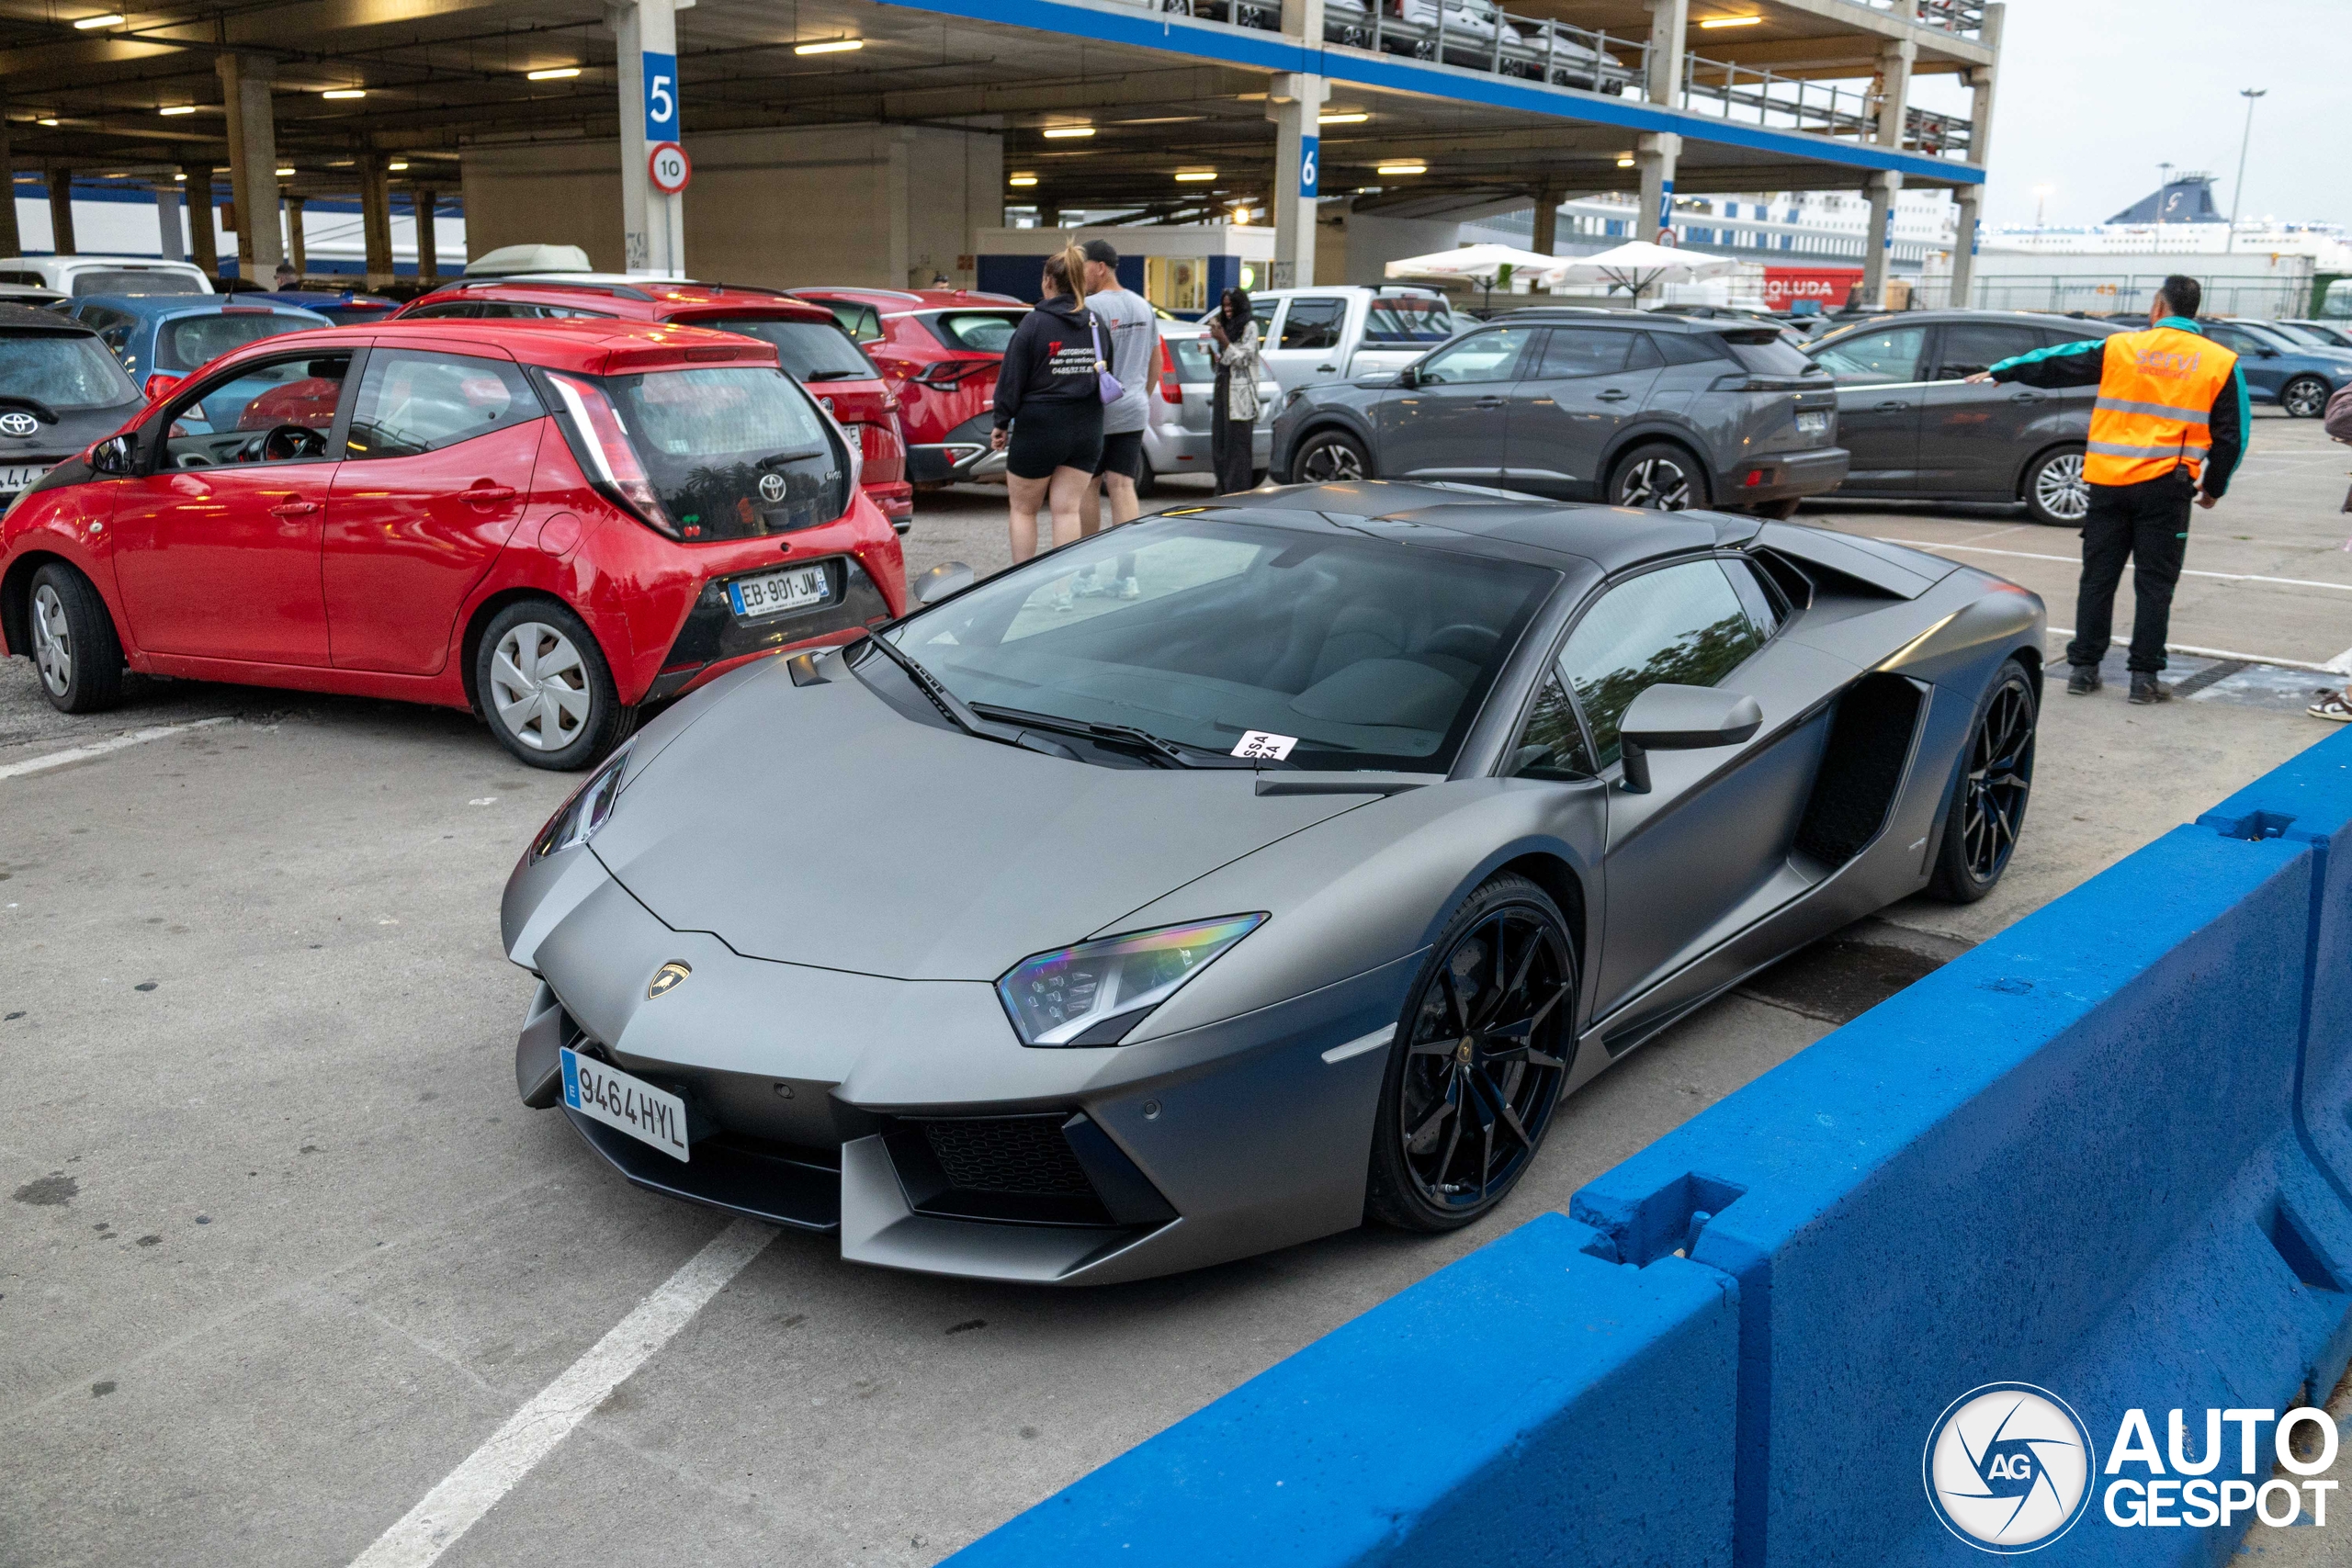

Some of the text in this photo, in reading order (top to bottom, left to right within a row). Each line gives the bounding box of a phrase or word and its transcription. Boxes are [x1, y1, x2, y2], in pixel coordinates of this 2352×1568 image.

[650, 75, 673, 123] 5
[661, 159, 680, 177] 10
[1303, 160, 1316, 186] 6
[1662, 192, 1671, 217] 7
[1763, 280, 1833, 296] OLUDA
[2134, 348, 2201, 372] servi
[569, 1084, 576, 1099] E
